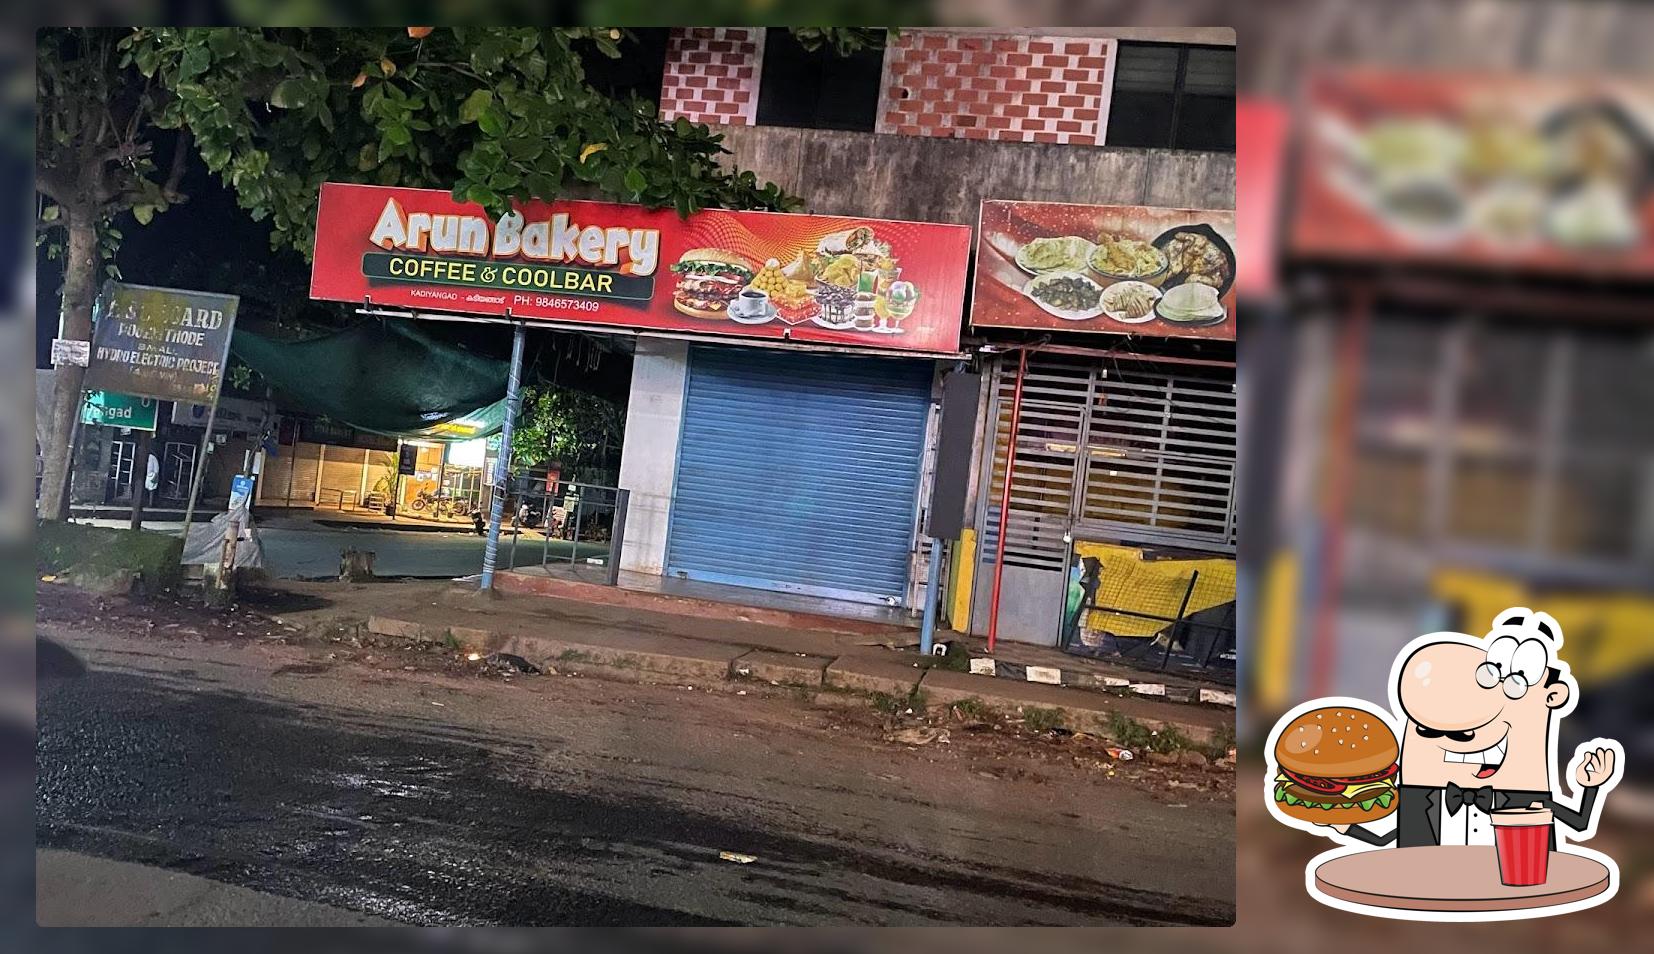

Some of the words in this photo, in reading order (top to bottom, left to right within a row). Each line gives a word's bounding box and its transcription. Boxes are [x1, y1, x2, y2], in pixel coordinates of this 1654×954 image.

[369, 197, 490, 257] Arun
[492, 209, 660, 276] Bakery
[389, 257, 476, 282] COFFEE
[481, 267, 498, 283] &
[502, 267, 613, 293] COOLBAR
[411, 289, 458, 300] KADIYANGAD
[513, 294, 533, 306] PH:
[535, 297, 600, 312] 9846573409
[97, 347, 130, 362] HYDRO
[130, 351, 177, 369] ELECTRIC
